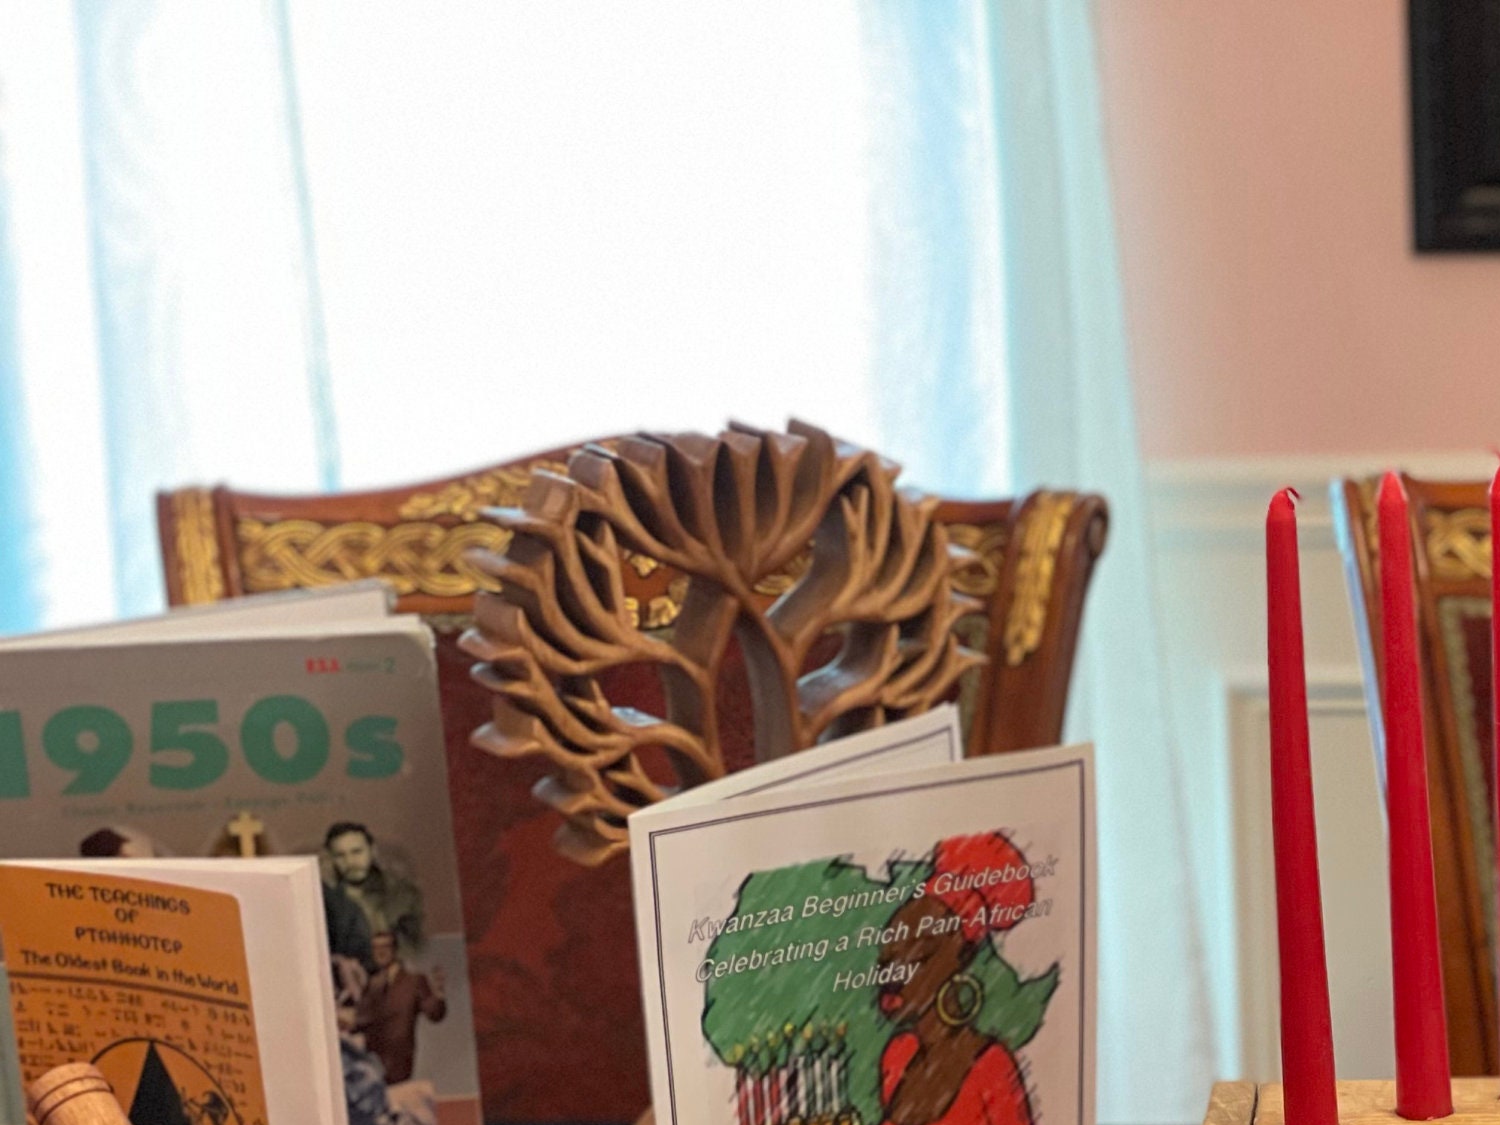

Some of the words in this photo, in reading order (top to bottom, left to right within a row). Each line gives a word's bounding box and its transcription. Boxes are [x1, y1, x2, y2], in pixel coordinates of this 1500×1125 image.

[0, 694, 405, 799] 1950s
[45, 882, 84, 900] THE
[89, 886, 190, 915] TEACHINGS
[115, 908, 139, 924] OF
[688, 903, 794, 944] Kwanzaa
[801, 879, 927, 918] Beginner's
[932, 854, 1059, 895] Guidebook
[695, 938, 829, 984] Celebrating
[835, 936, 850, 953] a
[856, 920, 909, 949] Rich
[915, 898, 1054, 939] Pan-African
[20, 949, 51, 966] The
[54, 952, 107, 971] Oldest
[112, 959, 151, 978] Book
[156, 966, 170, 981] in
[172, 968, 196, 987] the
[196, 975, 239, 996] World
[832, 961, 921, 993] Holiday
